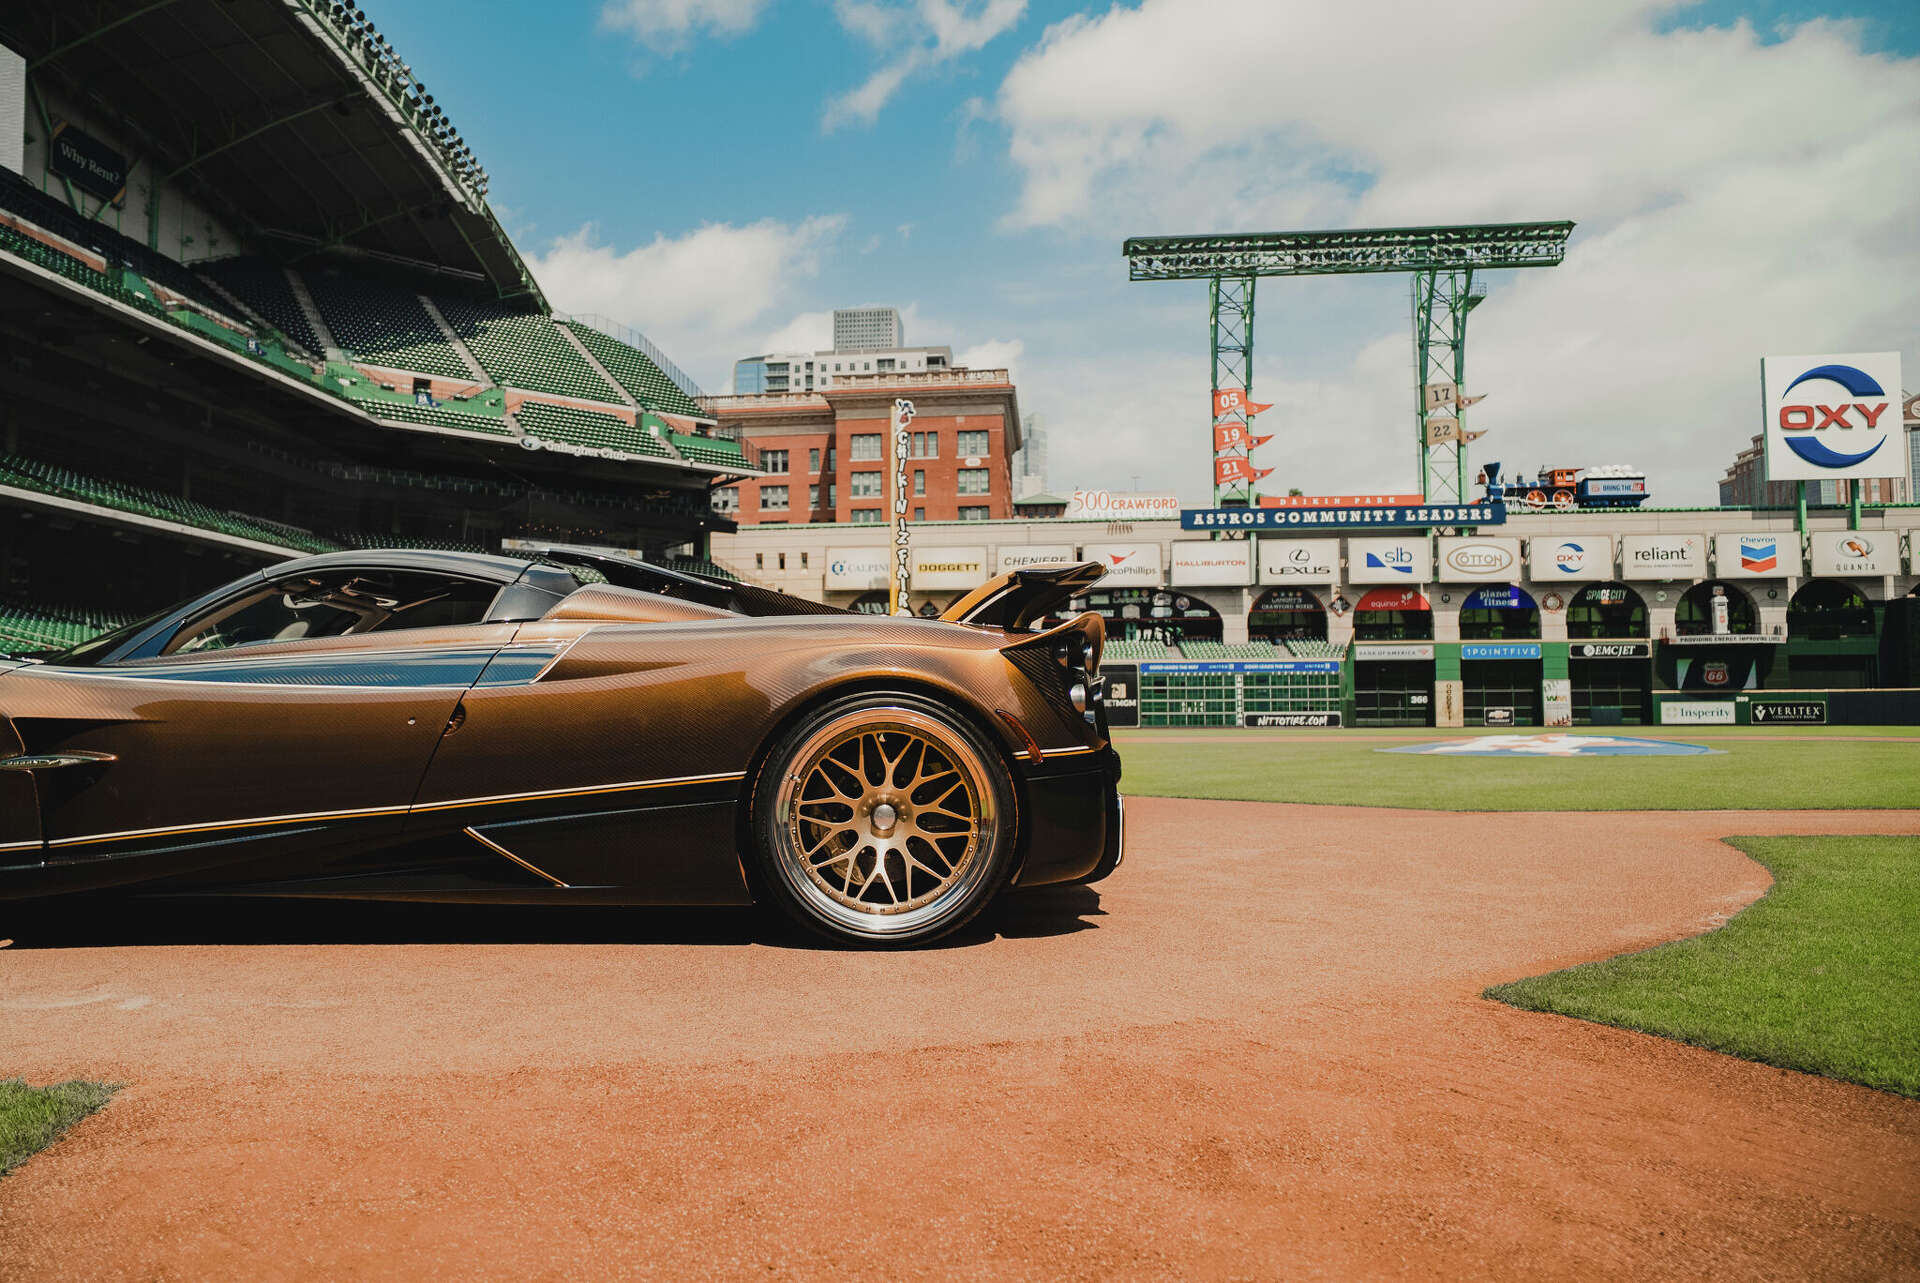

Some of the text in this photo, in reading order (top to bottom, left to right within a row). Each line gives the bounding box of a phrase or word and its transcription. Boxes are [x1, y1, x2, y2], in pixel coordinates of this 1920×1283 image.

[61, 142, 119, 185] Why Rent?
[1220, 392, 1239, 408] 05
[1433, 387, 1450, 402] 17
[1779, 402, 1889, 430] OXY
[1222, 428, 1240, 443] 19
[1433, 424, 1451, 438] 22
[545, 440, 627, 461] Gallagher Club
[895, 431, 909, 515] CHIKIN
[1222, 460, 1240, 475] 21
[1073, 488, 1178, 512] 500 CRAWFORD
[1279, 496, 1396, 506] DAIKIN PARK
[1193, 508, 1493, 525] ASTROS COMMUNITY LEADERS
[1384, 547, 1413, 564] slb
[1455, 551, 1503, 568] COTTON
[1556, 553, 1584, 562] OXY
[1635, 546, 1688, 561] reliant
[847, 563, 889, 573] CALPIN
[918, 563, 980, 573] DOGGETT
[1175, 559, 1247, 568] HALLIBURTON
[1835, 563, 1877, 572] QUANTA
[1269, 566, 1331, 576] LEXUS
[895, 548, 910, 609] FAIR
[1479, 589, 1512, 600] planet
[1586, 589, 1628, 601] SPACE CITY
[1370, 600, 1399, 609] equinor
[1466, 647, 1538, 657] 1POINTFIVE
[1595, 645, 1636, 656] EMCJET
[1707, 671, 1723, 681] 66
[1681, 706, 1730, 718] Insperity
[1768, 706, 1819, 716] VERITEX
[1257, 714, 1328, 727] NITTOTIRE.COM
